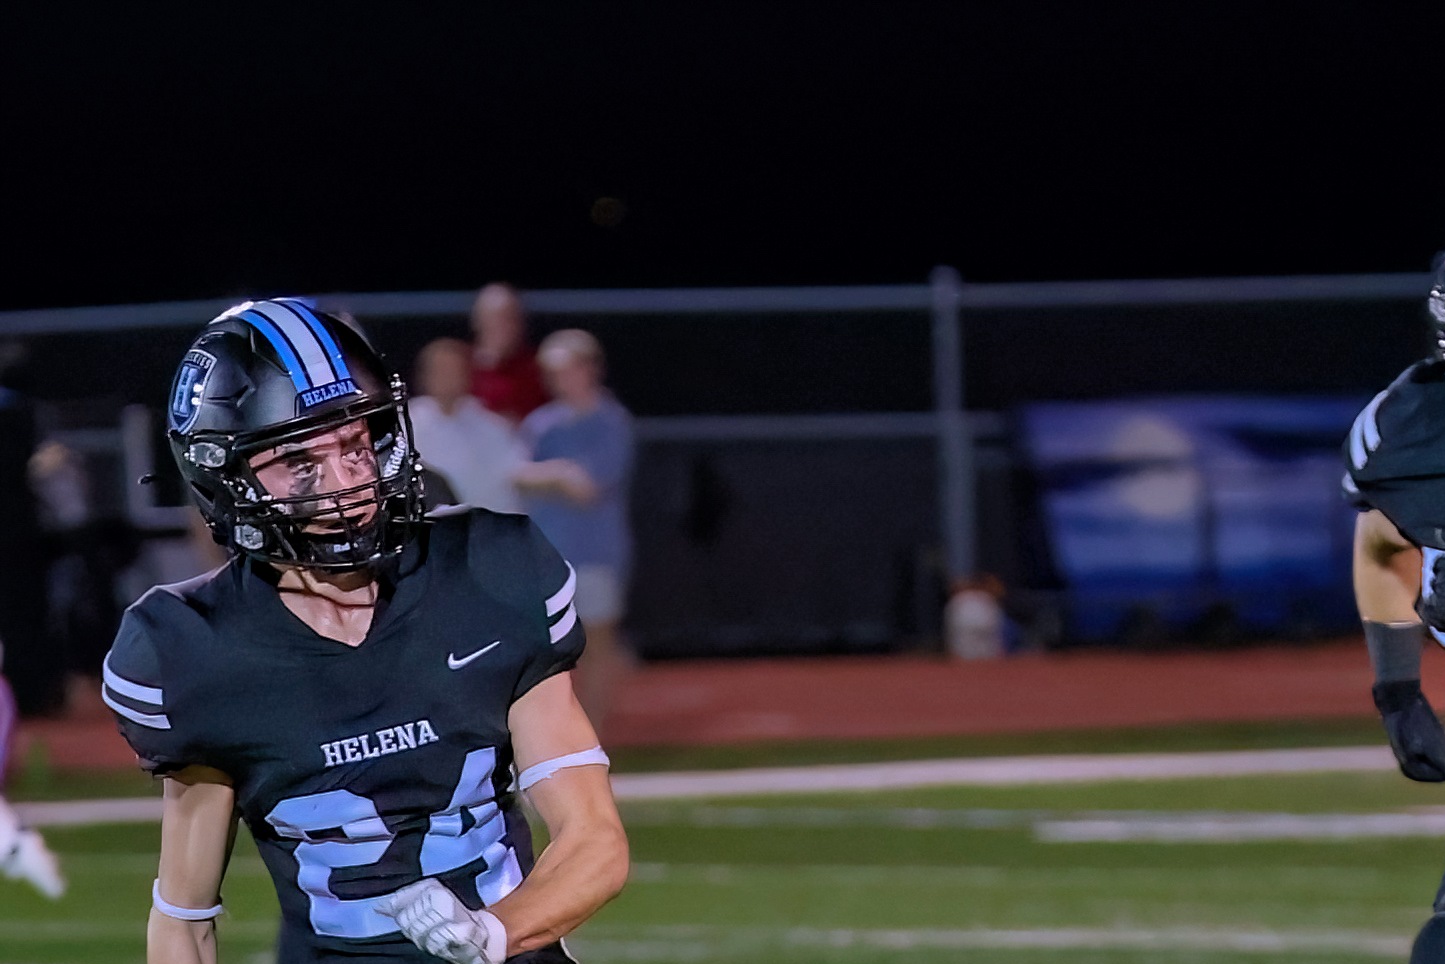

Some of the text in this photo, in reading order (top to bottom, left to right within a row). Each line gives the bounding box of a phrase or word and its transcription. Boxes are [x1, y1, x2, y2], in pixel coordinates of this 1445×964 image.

[301, 379, 357, 408] HELENA
[320, 719, 440, 768] HELENA
[264, 745, 525, 939] 24
